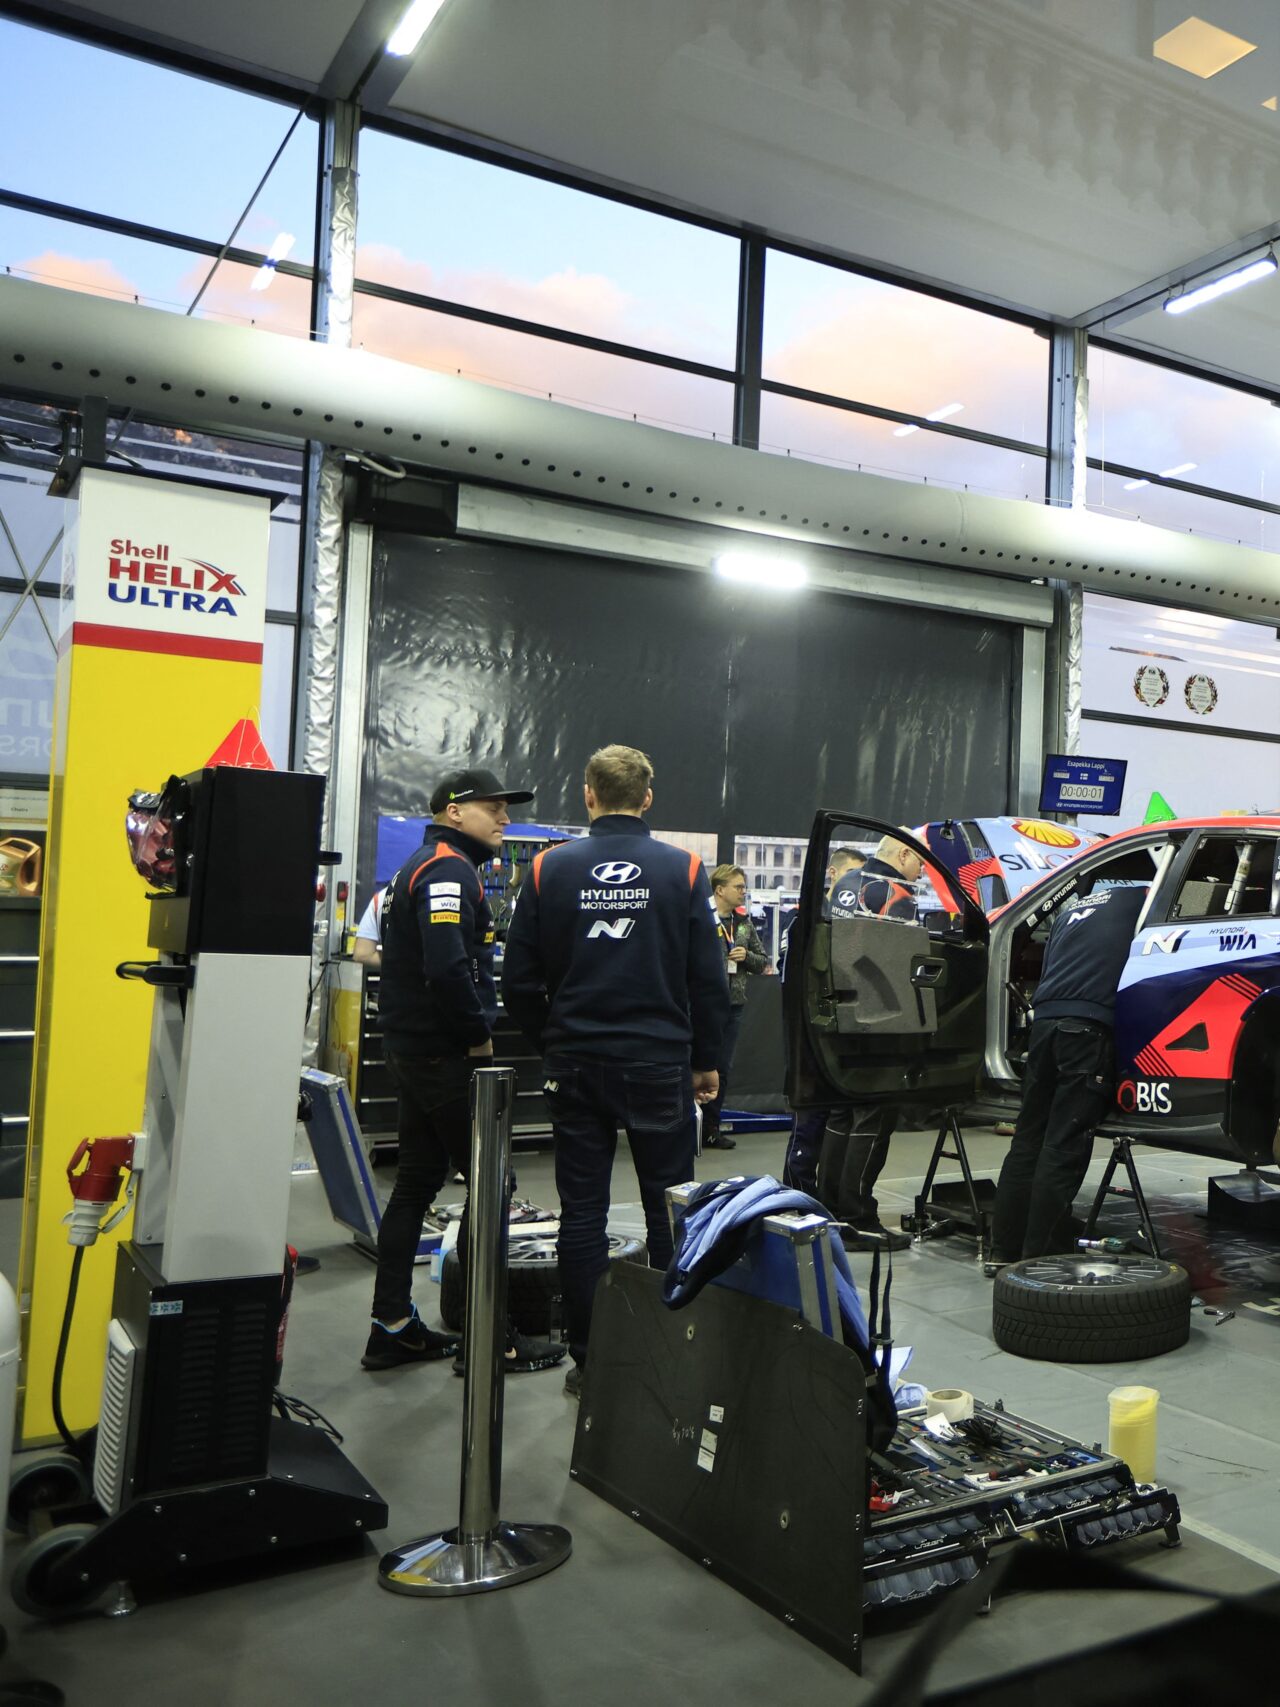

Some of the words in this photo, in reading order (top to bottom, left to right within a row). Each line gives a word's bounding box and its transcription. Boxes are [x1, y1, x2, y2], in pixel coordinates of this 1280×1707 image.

[110, 539, 169, 561] Shell
[108, 557, 242, 596] HELIX
[108, 582, 238, 617] ULTRA
[1067, 760, 1091, 768] Esapekka
[1091, 762, 1105, 770] Lappi
[1061, 785, 1102, 799] 00:00:01
[581, 888, 650, 901] HYUNDAI
[1052, 878, 1078, 903] HYUNDAI
[581, 901, 648, 910] MOTORSPORT
[1209, 926, 1245, 935] HYUNDAI
[1219, 932, 1257, 952] WIA
[1117, 1080, 1172, 1113] OBIS
